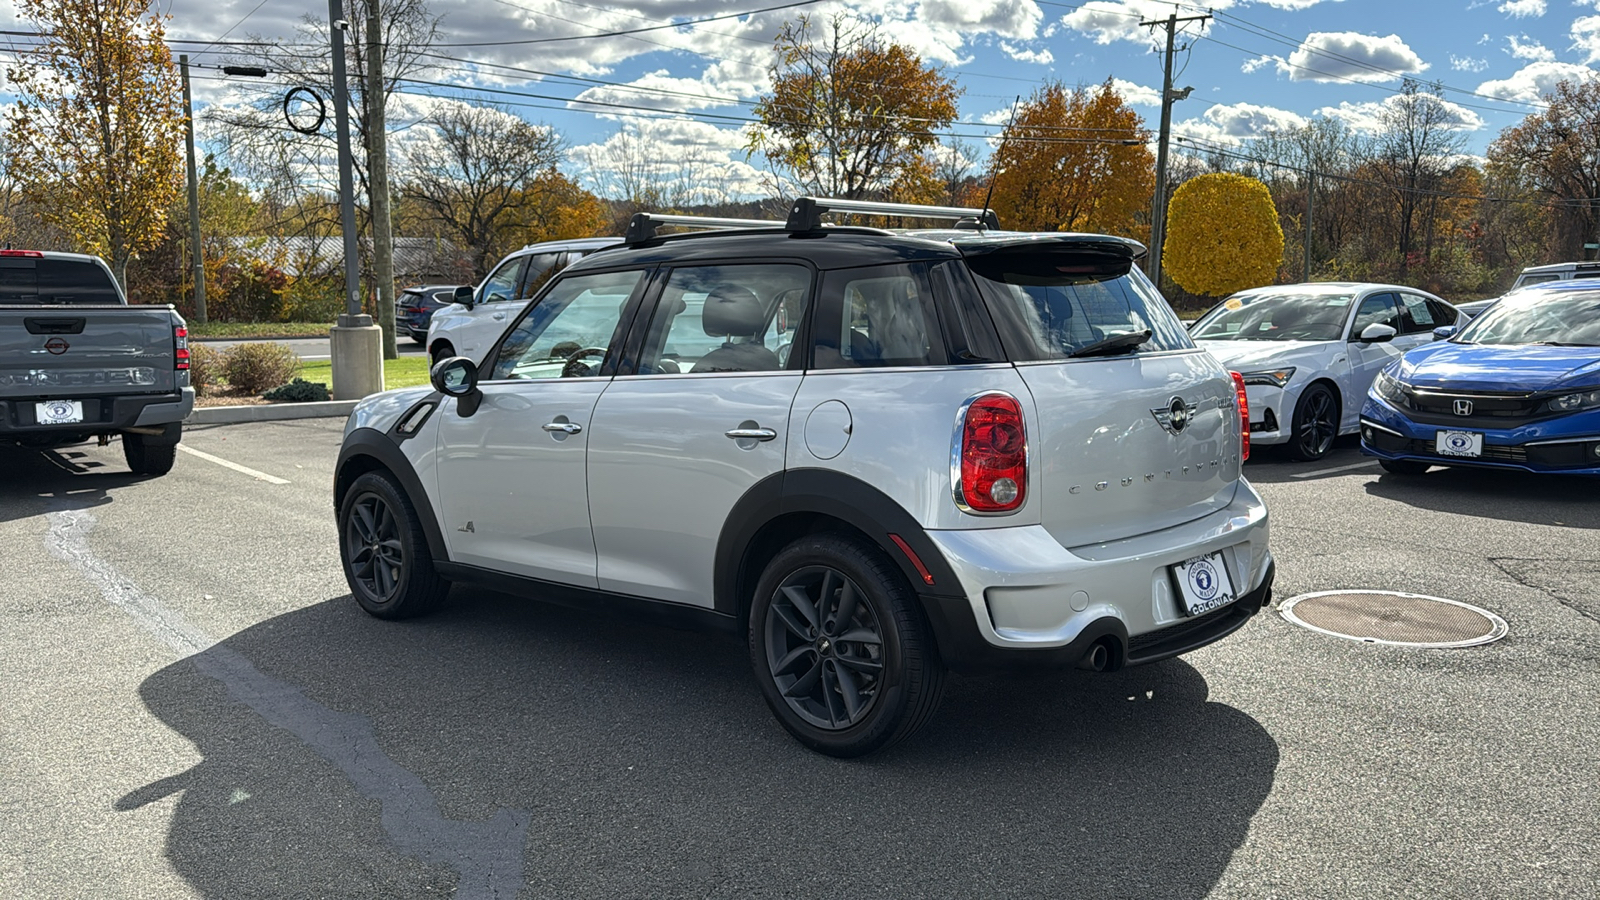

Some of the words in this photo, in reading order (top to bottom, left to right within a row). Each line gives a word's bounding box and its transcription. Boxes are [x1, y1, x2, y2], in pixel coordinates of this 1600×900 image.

[1438, 450, 1478, 458] COLONIAL
[1190, 562, 1213, 579] COLONIAL
[1199, 585, 1216, 598] MAZDA
[1192, 595, 1234, 615] COLONIAL
